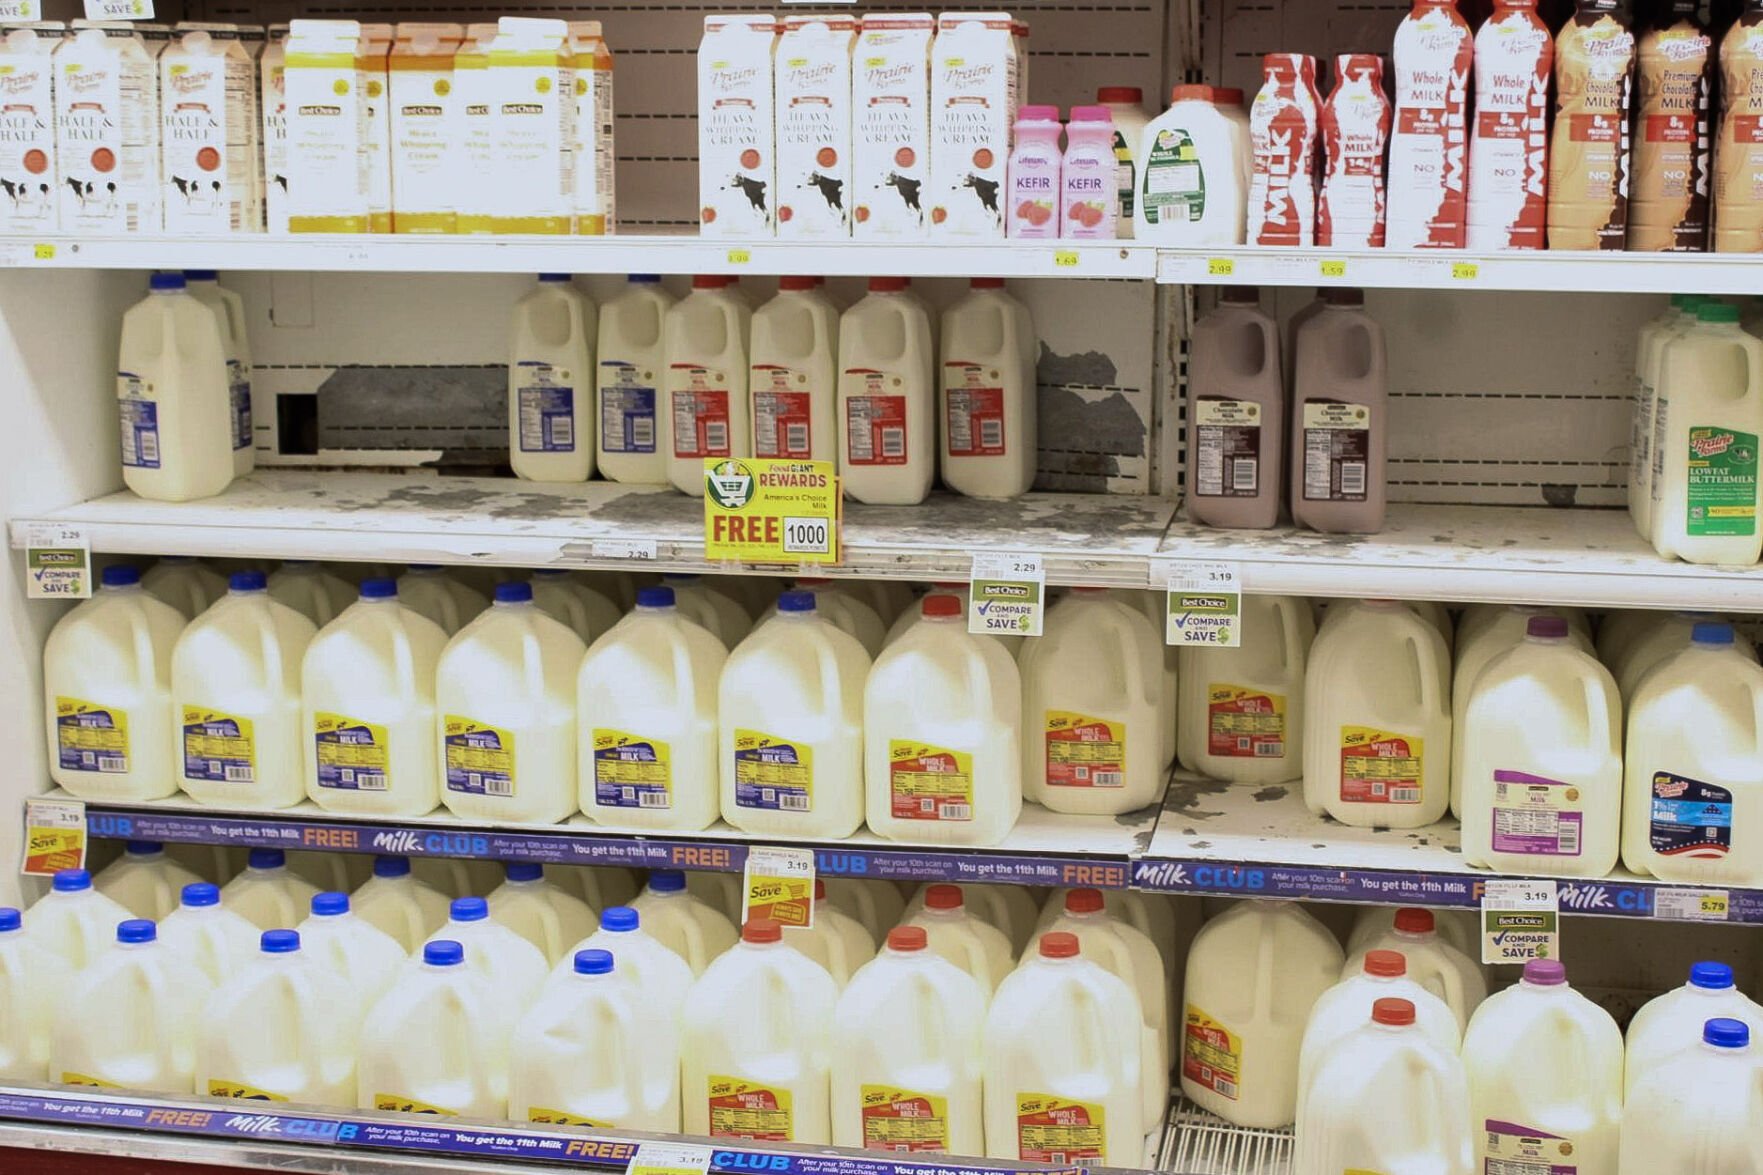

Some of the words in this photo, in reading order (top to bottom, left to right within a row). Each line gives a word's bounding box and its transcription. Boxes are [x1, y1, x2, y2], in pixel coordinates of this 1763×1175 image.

[1412, 72, 1444, 84] Whole
[1492, 75, 1526, 88] Whole
[1411, 90, 1444, 101] MILK
[1491, 94, 1525, 105] MILK
[1585, 97, 1618, 108] MILK
[1661, 98, 1695, 108] MILK
[1344, 144, 1373, 152] MILK
[1414, 164, 1436, 172] NO
[1494, 168, 1516, 176] NO
[1266, 128, 1292, 226] MILK
[1588, 171, 1611, 180] NO
[1664, 171, 1686, 180] NO
[1016, 178, 1050, 188] KEFIR
[1068, 178, 1102, 190] KEFIR
[1209, 264, 1232, 274] 2.99
[791, 464, 814, 472] GIANT
[1690, 467, 1731, 475] LOWFAT
[760, 474, 827, 488] REWARDS
[1690, 476, 1755, 484] BUTTERMILK
[801, 494, 827, 502] Choice
[714, 515, 780, 543] FREE
[788, 524, 825, 544] 1000
[628, 550, 648, 558] 2.29
[1014, 564, 1036, 572] 2.29
[1208, 572, 1232, 581] 3.19
[42, 584, 70, 592] SAVE
[1199, 599, 1226, 608] Choice
[989, 606, 1032, 615] COMPARE
[986, 618, 1018, 629] SAVE
[1187, 618, 1232, 626] COMPARE
[1184, 631, 1216, 642] SAVE
[1236, 700, 1261, 708] WHOLE
[1244, 706, 1261, 714] MILK
[1074, 727, 1100, 736] WHOLE
[1345, 734, 1365, 744] Save
[1370, 742, 1398, 751] WHOLE
[620, 752, 639, 762] MILK
[762, 754, 780, 763] MILK
[1378, 750, 1398, 758] MILK
[918, 756, 945, 765] WHOLE
[89, 816, 132, 836] LUB
[210, 825, 226, 836] You
[229, 827, 243, 838] get
[245, 827, 259, 836] the
[281, 829, 300, 839] Milk
[304, 828, 359, 848] FREE!
[30, 836, 58, 850] Save
[373, 831, 424, 852] Milk
[425, 834, 488, 855] CLUB
[572, 844, 590, 854] You
[592, 846, 607, 856] get
[609, 846, 624, 856] the
[648, 848, 668, 858] Milk
[672, 846, 730, 866] FREE!
[787, 861, 808, 870] 3.19
[819, 854, 867, 874] LUB
[958, 862, 976, 872] You
[978, 864, 994, 874] get
[996, 864, 1012, 874] the
[1015, 865, 1034, 875] 11th
[1037, 866, 1058, 876] Milk
[1063, 865, 1124, 887] FREE!
[1135, 864, 1192, 886] Milk
[1194, 866, 1264, 889] CLUB
[1360, 878, 1380, 890] You
[1382, 880, 1398, 892] get
[1401, 880, 1419, 890] the
[1421, 881, 1442, 892] 11th
[1444, 882, 1466, 894] Milk
[750, 886, 782, 899] Save
[1524, 892, 1548, 902] 3.19
[1558, 882, 1614, 909] Milk
[1616, 890, 1652, 911] CL
[1701, 902, 1725, 912] 5.79
[1499, 917, 1513, 926] Best
[1514, 917, 1544, 926] Choice
[1504, 935, 1549, 944] COMPARE
[1502, 948, 1534, 958] SAVE
[711, 1086, 730, 1094] Save
[737, 1093, 765, 1102] WHOLE
[865, 1095, 885, 1104] Save
[892, 1102, 919, 1110] WHOLE
[1020, 1103, 1041, 1112] Save
[43, 1102, 62, 1111] You
[62, 1104, 80, 1113] get
[82, 1106, 98, 1114] the
[122, 1109, 144, 1118] Milk
[146, 1108, 212, 1127] FREE!
[1048, 1110, 1076, 1119] WHOLE
[225, 1114, 282, 1132] Milk
[286, 1120, 358, 1140] CLUB
[364, 1126, 384, 1134] After
[368, 1134, 387, 1142] your
[455, 1134, 474, 1144] You
[475, 1136, 495, 1146] get
[496, 1136, 514, 1146] the
[516, 1138, 538, 1148] 11th
[539, 1140, 562, 1150] Milk
[564, 1140, 635, 1160] FREE!
[713, 1152, 791, 1171] CLUB
[797, 1158, 818, 1166] After
[838, 1160, 856, 1168] 10th
[802, 1166, 821, 1174] your
